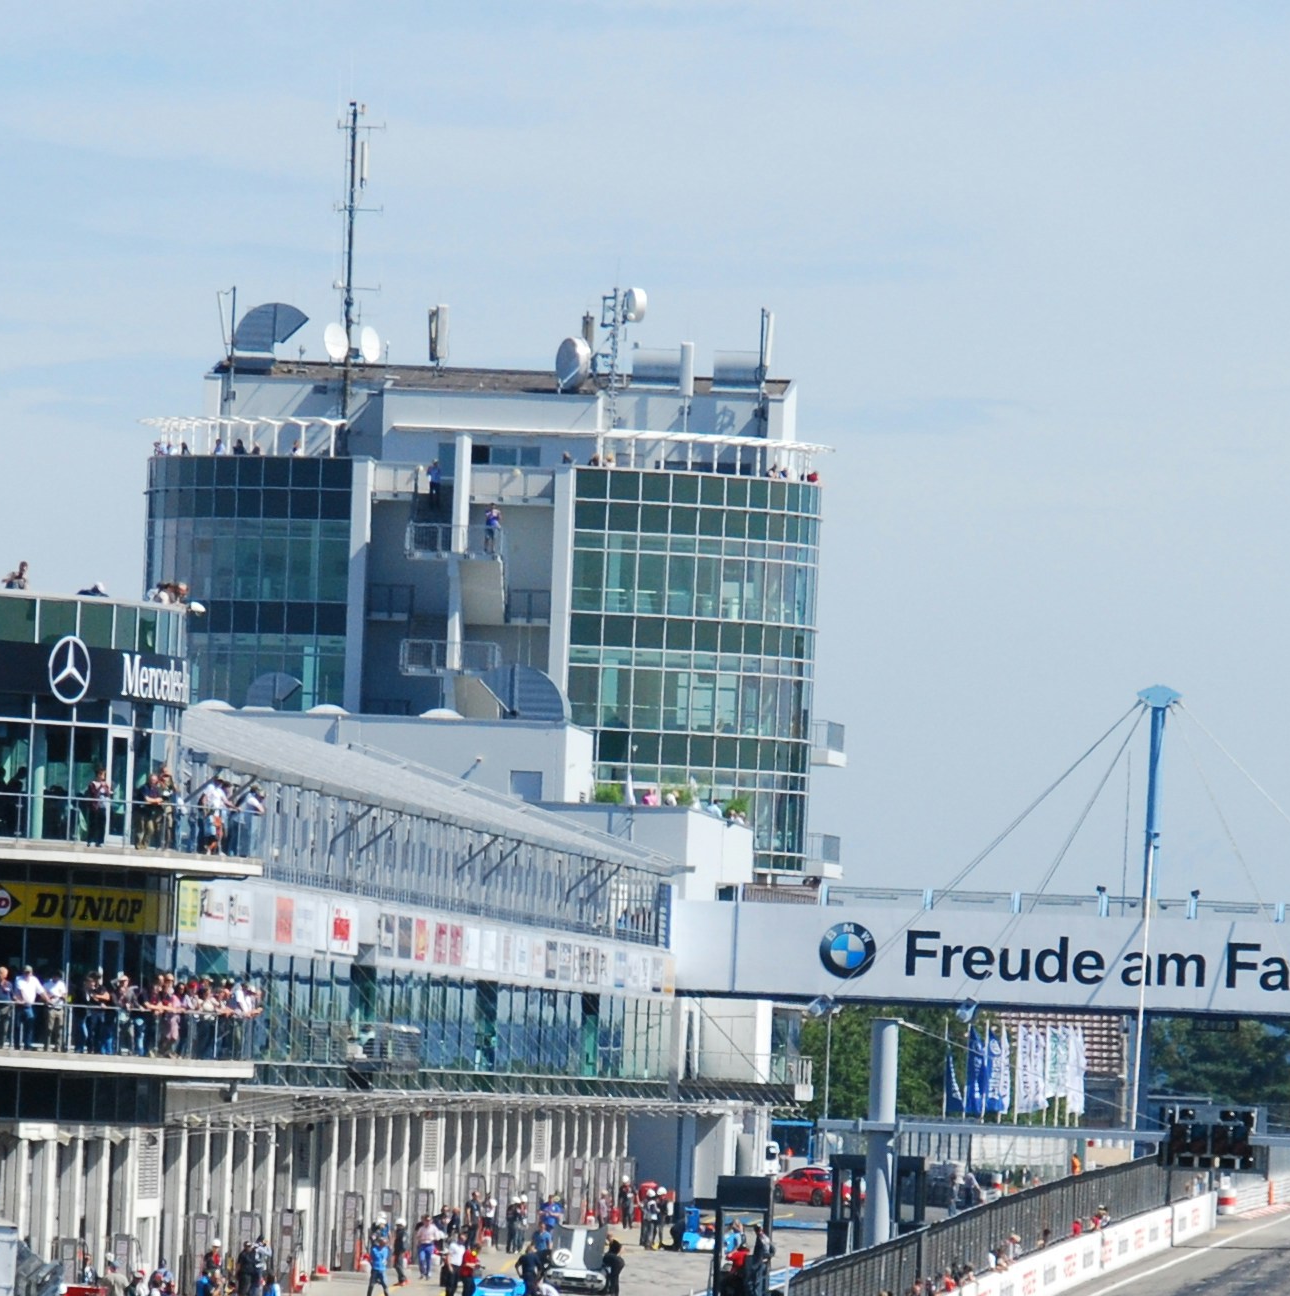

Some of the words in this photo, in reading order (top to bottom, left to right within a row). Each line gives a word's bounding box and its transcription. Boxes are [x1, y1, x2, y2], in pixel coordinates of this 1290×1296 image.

[31, 893, 143, 923] DUNLOP
[905, 930, 1105, 985] Freude
[1121, 951, 1206, 987] am
